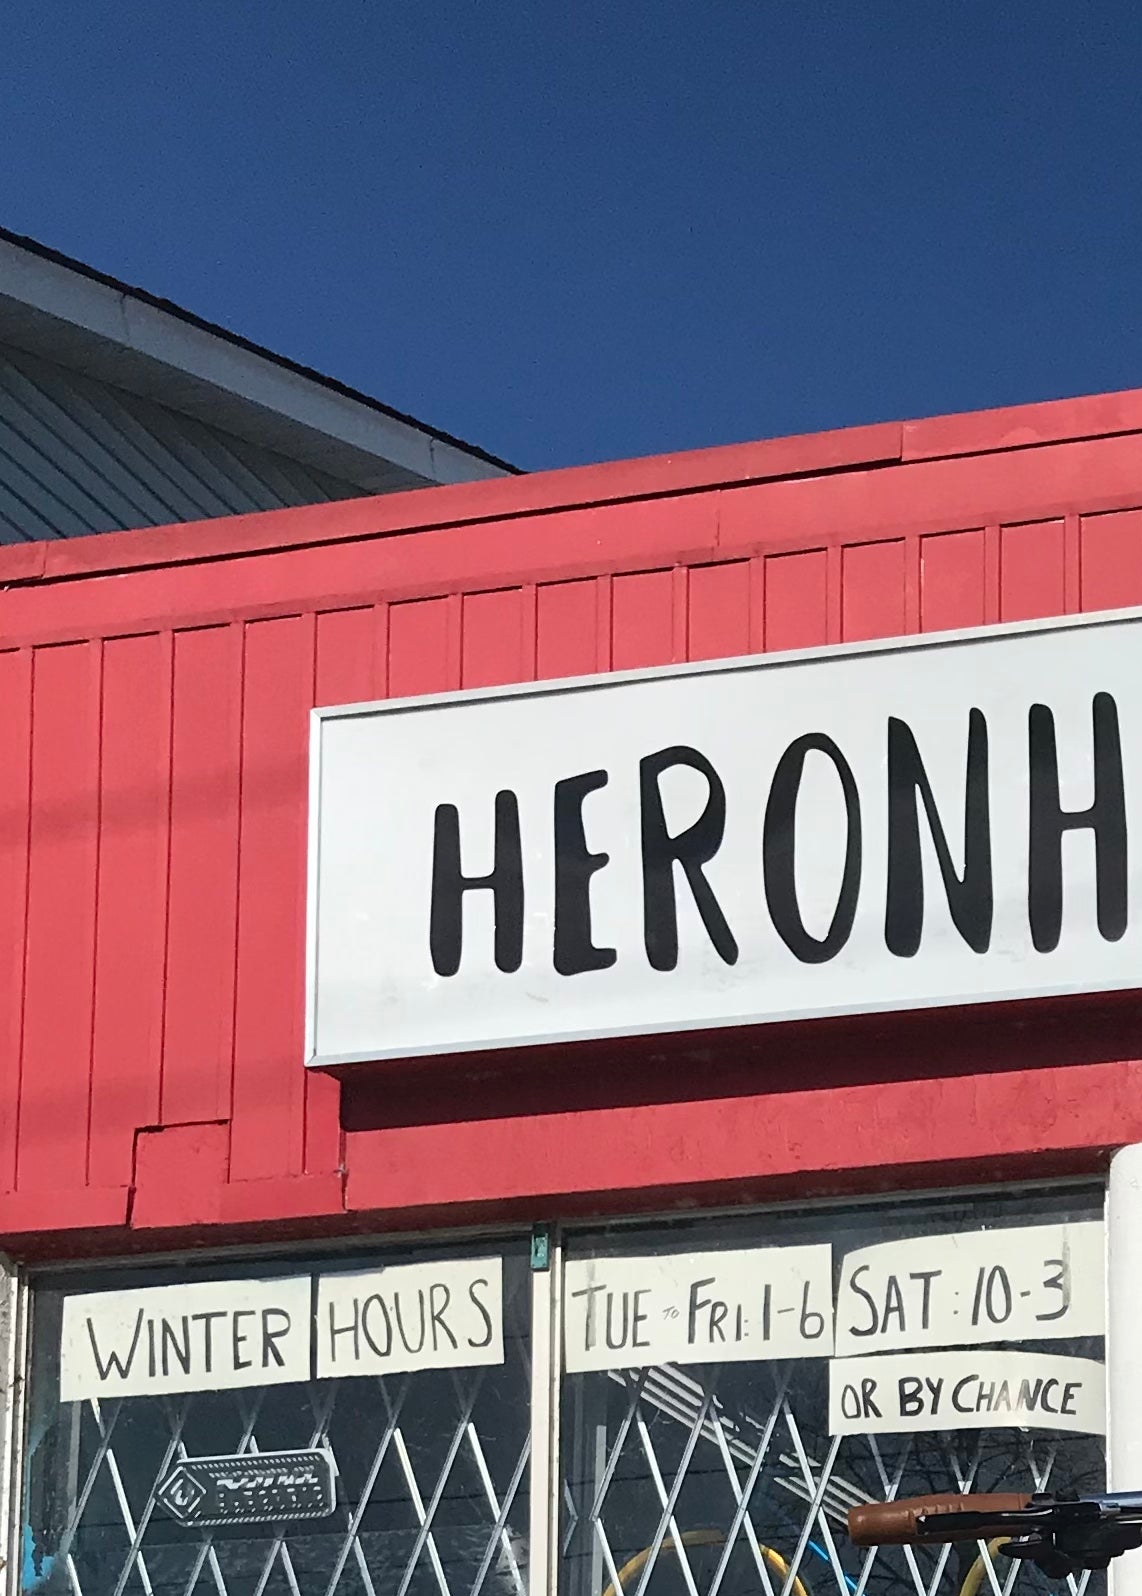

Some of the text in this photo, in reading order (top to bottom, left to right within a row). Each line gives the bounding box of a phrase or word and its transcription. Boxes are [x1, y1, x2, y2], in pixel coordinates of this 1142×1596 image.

[87, 1278, 494, 1381] WINTER HOURS
[571, 1284, 652, 1352] TUE
[663, 1306, 680, 1319] TO
[842, 1373, 1082, 1418] OR BY CHANCE
